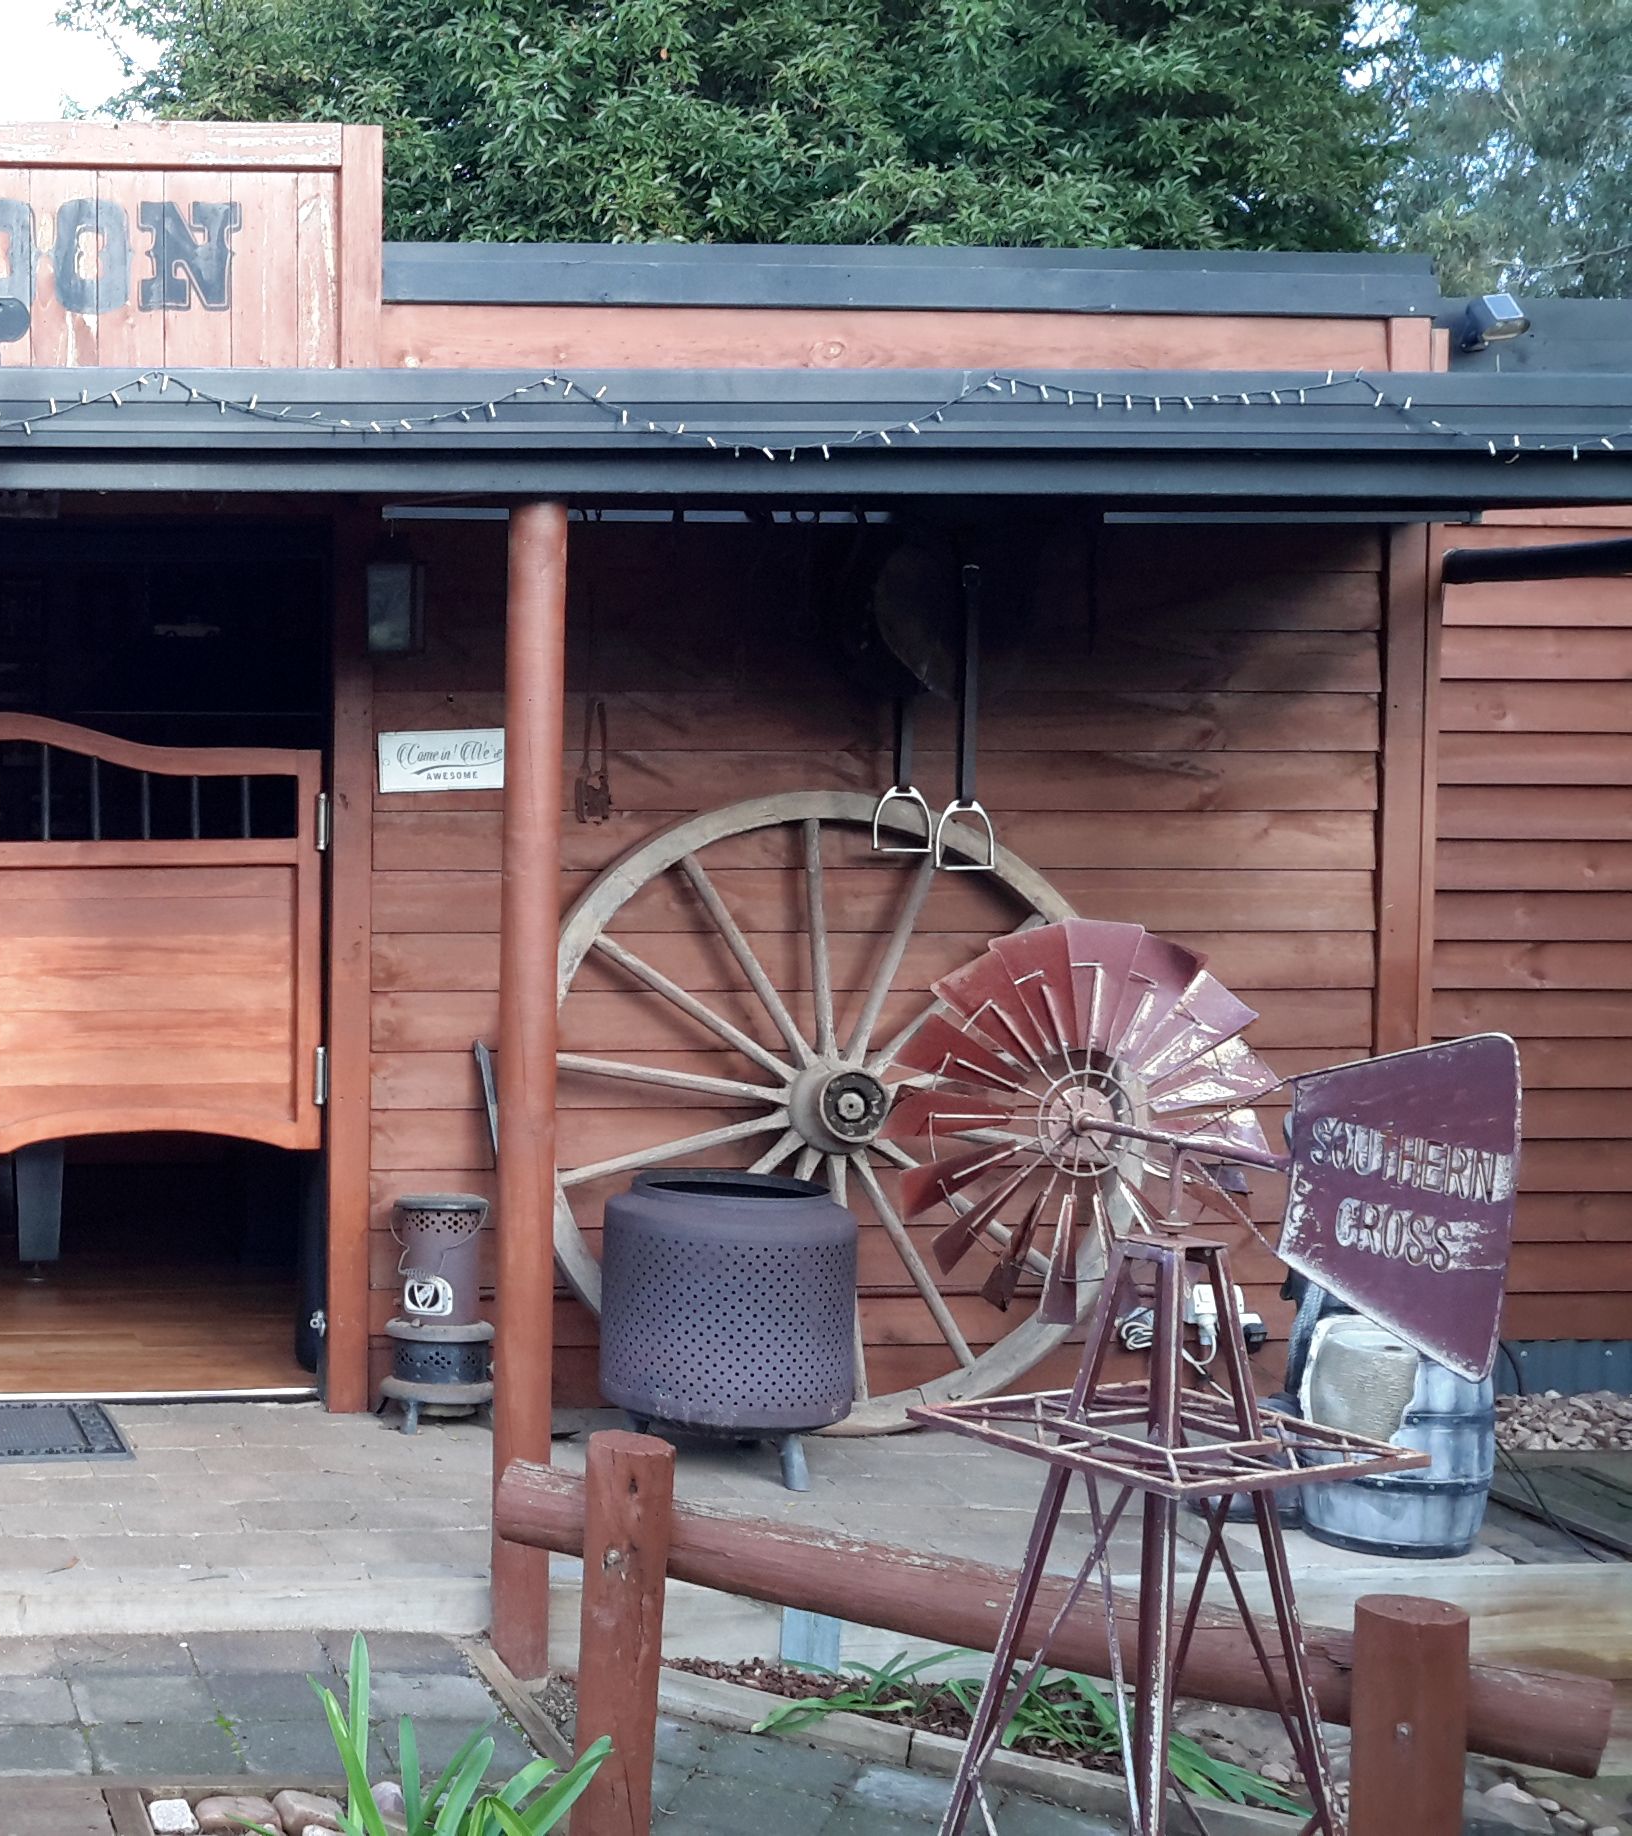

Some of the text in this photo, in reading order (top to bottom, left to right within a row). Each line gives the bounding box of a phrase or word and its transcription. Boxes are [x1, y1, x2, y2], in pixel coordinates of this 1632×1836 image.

[396, 742, 440, 770] Come
[426, 771, 479, 781] AWESOME
[1310, 1116, 1496, 1205] SOUTHERN
[1335, 1197, 1456, 1274] CROSS
